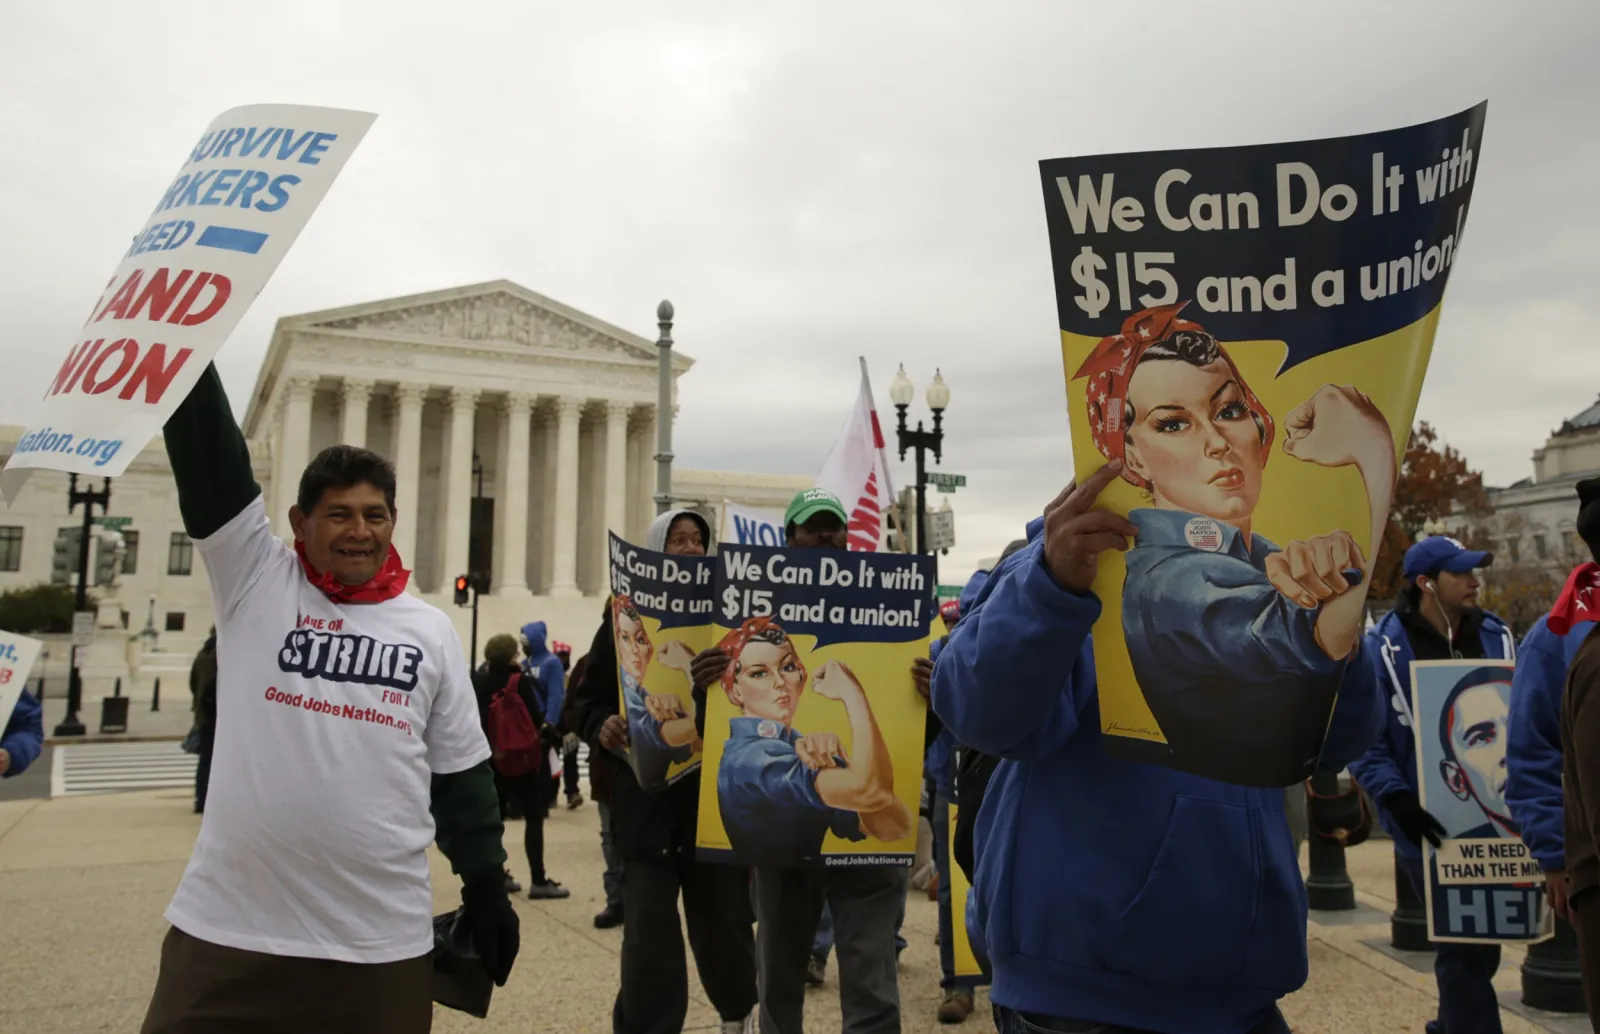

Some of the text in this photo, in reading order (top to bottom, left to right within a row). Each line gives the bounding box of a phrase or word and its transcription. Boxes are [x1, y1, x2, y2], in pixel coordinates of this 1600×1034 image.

[1056, 128, 1472, 234] We Can Do It with
[1071, 246, 1179, 318] $15
[1197, 258, 1297, 313] and
[1312, 269, 1345, 307] a
[43, 337, 194, 405] NION
[610, 537, 710, 584] We Can Do It
[724, 551, 924, 590] We Can Do It with
[611, 564, 631, 596] $15
[634, 591, 667, 611] and
[671, 599, 684, 613] a
[721, 585, 921, 627] $15 and a union!
[328, 618, 344, 632] ON
[280, 630, 420, 689] STRIKE
[382, 690, 402, 705] FOR
[825, 856, 912, 866] GoodJobsNation.org
[1441, 863, 1486, 878] THAN
[1490, 862, 1518, 877] THE
[1460, 843, 1526, 859] WE NEED
